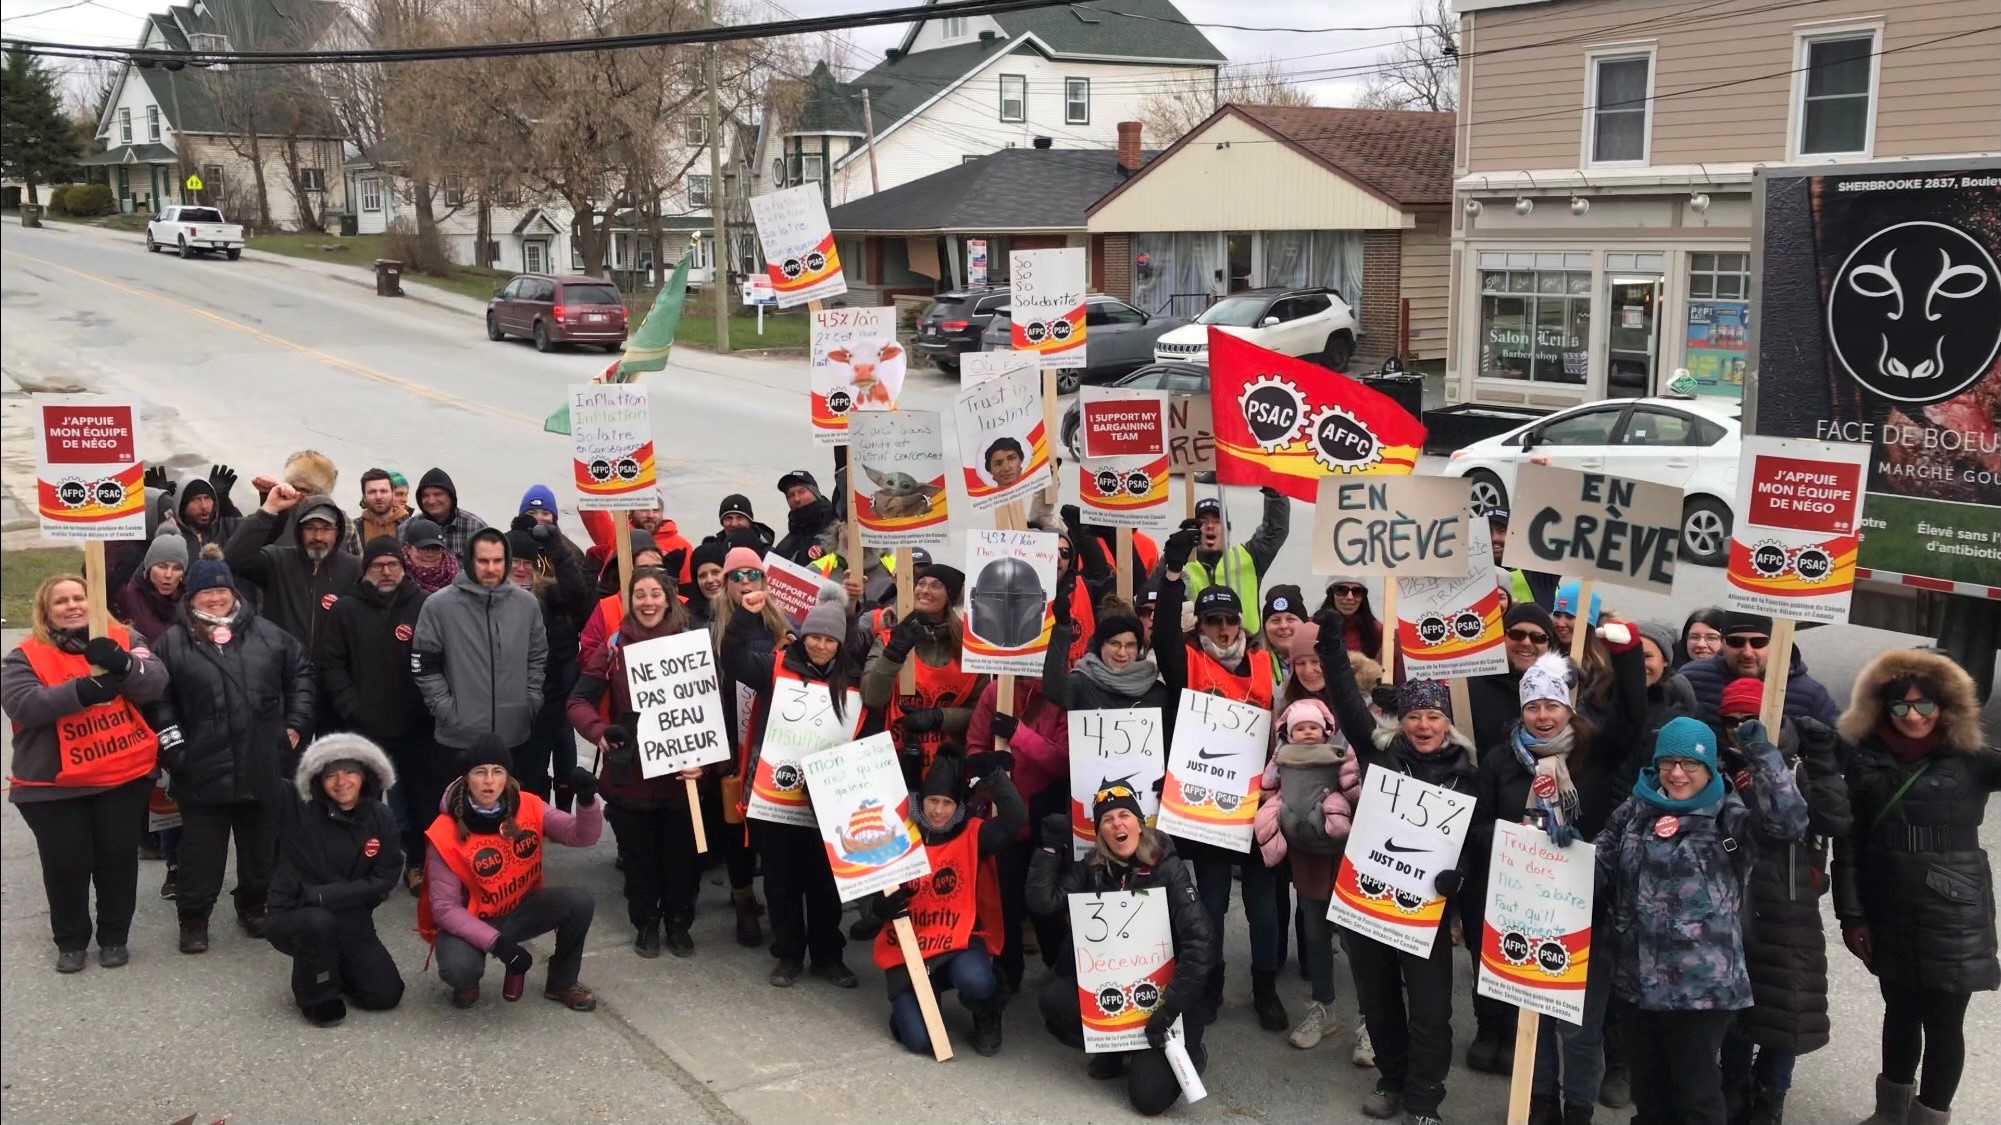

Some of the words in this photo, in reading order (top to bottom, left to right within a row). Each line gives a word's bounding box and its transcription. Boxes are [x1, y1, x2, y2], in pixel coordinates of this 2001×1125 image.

[1839, 179, 1923, 192] SHERBROOKE
[1924, 178, 1958, 189] 2837,
[784, 264, 800, 273] AFPC
[807, 257, 824, 267] PSAC
[1014, 293, 1080, 308] Solidarité
[1028, 328, 1045, 336] AFPC
[1053, 327, 1070, 335] PSAC
[1489, 329, 1529, 344] Salon
[576, 393, 646, 407] Inflation
[831, 397, 850, 407] AFPC
[62, 416, 114, 426] J'APPUIE
[1095, 413, 1140, 422] SUPPORT
[1141, 412, 1157, 421] MY
[50, 428, 80, 437] MON
[83, 426, 128, 437] ÉQUIPE
[1093, 421, 1155, 432] BARGAINING
[1248, 400, 1293, 428] PSAC
[1321, 423, 1370, 456] AFPC
[1816, 420, 1875, 443] FACE
[1882, 424, 1915, 447] DE
[62, 439, 79, 449] DE
[82, 437, 117, 449] NÉGO
[1110, 432, 1139, 441] TEAM
[592, 464, 609, 474] AFPC
[619, 464, 637, 474] PSAC
[1774, 470, 1837, 486] J'APPUIE
[1098, 477, 1117, 487] AFPC
[1128, 479, 1148, 490] PSAC
[1580, 473, 1636, 508] EN
[1758, 482, 1794, 496] MON
[1797, 484, 1851, 501] ÉQUIPE
[62, 488, 85, 499] AFPC
[98, 489, 121, 499] PSAC
[1338, 482, 1389, 511] EN
[1769, 497, 1789, 510] DE
[1792, 498, 1836, 514] NÉGO
[1861, 517, 1887, 529] otre
[1917, 521, 1954, 538] Élevé
[1957, 529, 1988, 542] sans
[1332, 510, 1459, 569] GRÈVE
[1528, 504, 1681, 585] GRÈVE
[1756, 553, 1783, 566] AFPC
[1799, 558, 1826, 571] PSAC
[771, 578, 807, 600] SUPPORT
[776, 599, 798, 615] TEAM
[1422, 624, 1444, 635] AFPC
[1457, 621, 1479, 631] PSAC
[631, 662, 657, 684] NE
[659, 650, 711, 677] SOYEZ
[636, 688, 666, 709] PAS
[673, 674, 718, 700] QU'UN
[658, 705, 705, 731] BEAU
[1190, 692, 1260, 737] 4,5%
[643, 730, 719, 761] PARLEUR
[1083, 716, 1154, 759] 4,5%
[775, 770, 797, 782] AFPC
[1186, 760, 1208, 773] JUST
[1210, 766, 1224, 777] DO
[1227, 770, 1237, 781] IT
[1185, 784, 1205, 797] AFPC
[1216, 792, 1237, 805] PSAC
[1380, 774, 1466, 835] 4,5%
[475, 853, 501, 872] PSAC
[516, 834, 538, 853] AFPC
[1501, 830, 1569, 863] Trudeau
[1368, 849, 1395, 868] JUST
[1395, 860, 1412, 875] DO
[1413, 867, 1427, 881] IT
[1525, 860, 1555, 880] dors
[1077, 940, 1169, 974] Décevant
[1505, 939, 1527, 954] AFPC
[1540, 949, 1564, 965] PSAC
[1101, 995, 1123, 1006] AFPC
[1135, 990, 1156, 1001] PSAC
